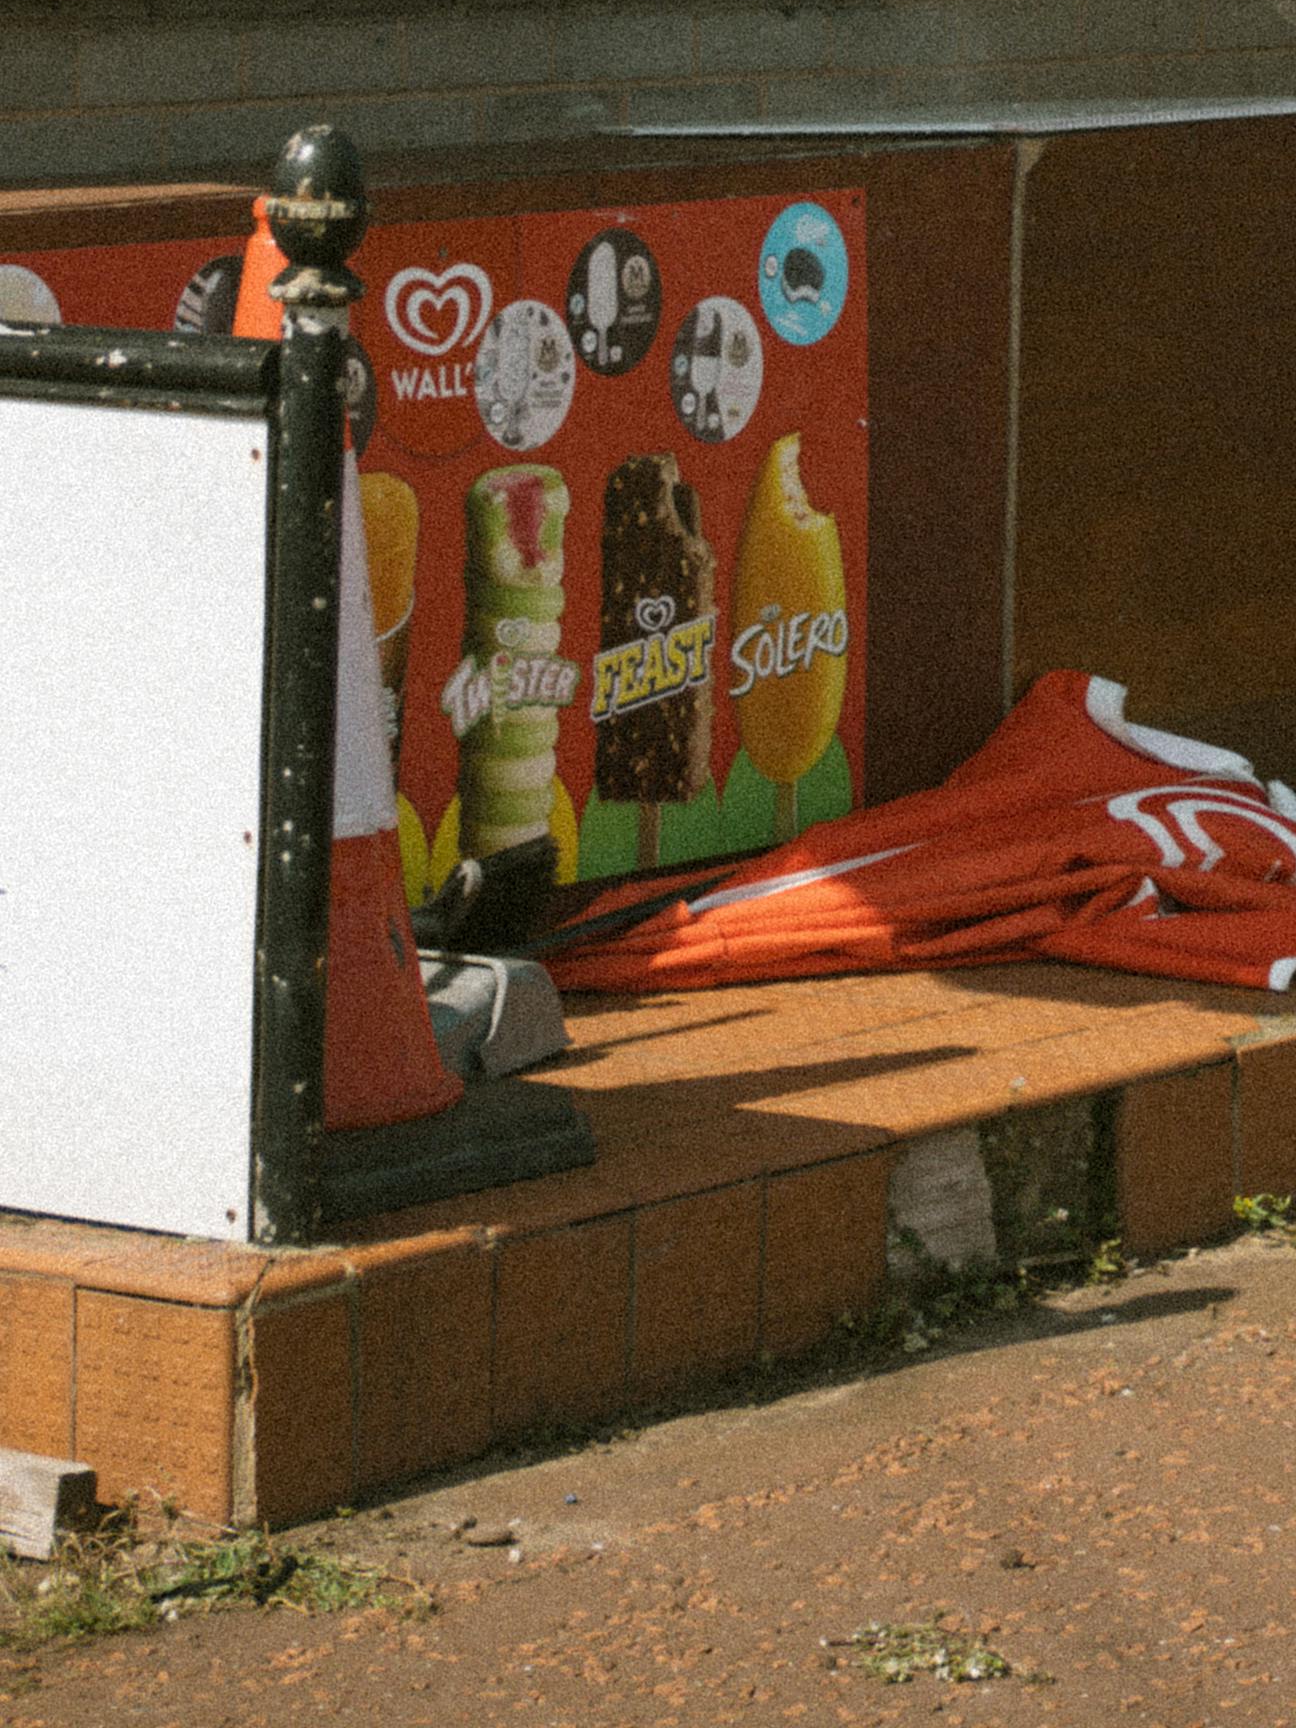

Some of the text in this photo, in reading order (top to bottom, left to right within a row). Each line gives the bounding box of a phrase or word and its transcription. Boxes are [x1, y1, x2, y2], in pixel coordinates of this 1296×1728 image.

[389, 364, 474, 402] WALL'
[591, 612, 716, 723] FEAST
[728, 608, 849, 697] SOLERO
